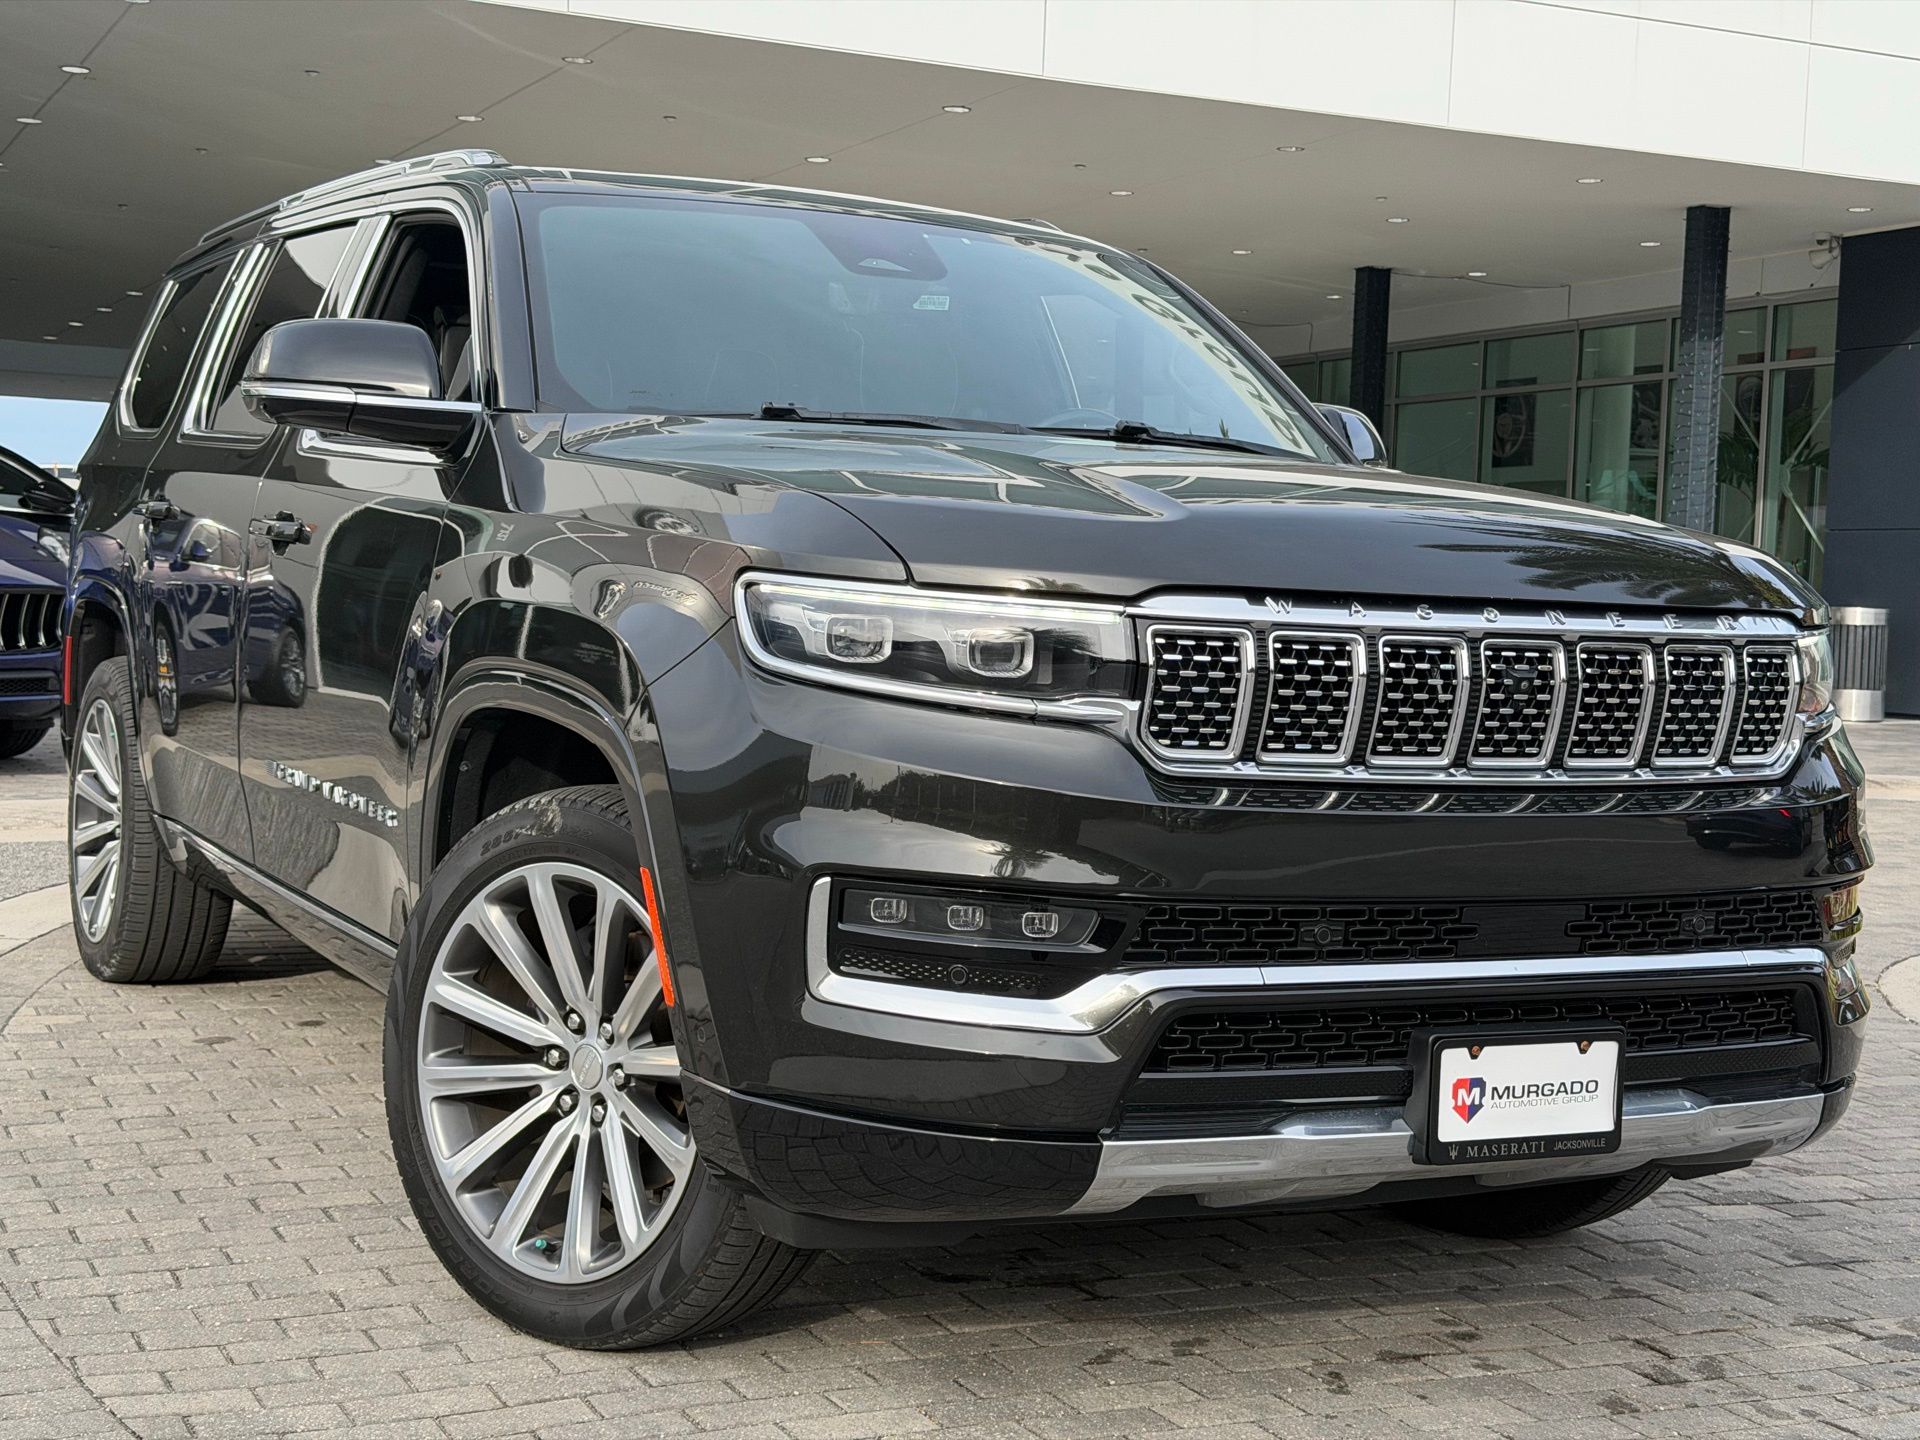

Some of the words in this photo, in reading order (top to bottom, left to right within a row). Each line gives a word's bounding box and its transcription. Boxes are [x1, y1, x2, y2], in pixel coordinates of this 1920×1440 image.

[1264, 597, 1738, 629] WAGONEER
[1457, 1087, 1480, 1106] M
[1491, 1079, 1599, 1101] MURGADO
[1490, 1097, 1559, 1110] AUTOMOTIVE
[1562, 1094, 1599, 1105] GROUP
[1466, 1141, 1546, 1158] MASERATI
[1553, 1137, 1607, 1151] JACKSONVILLE
